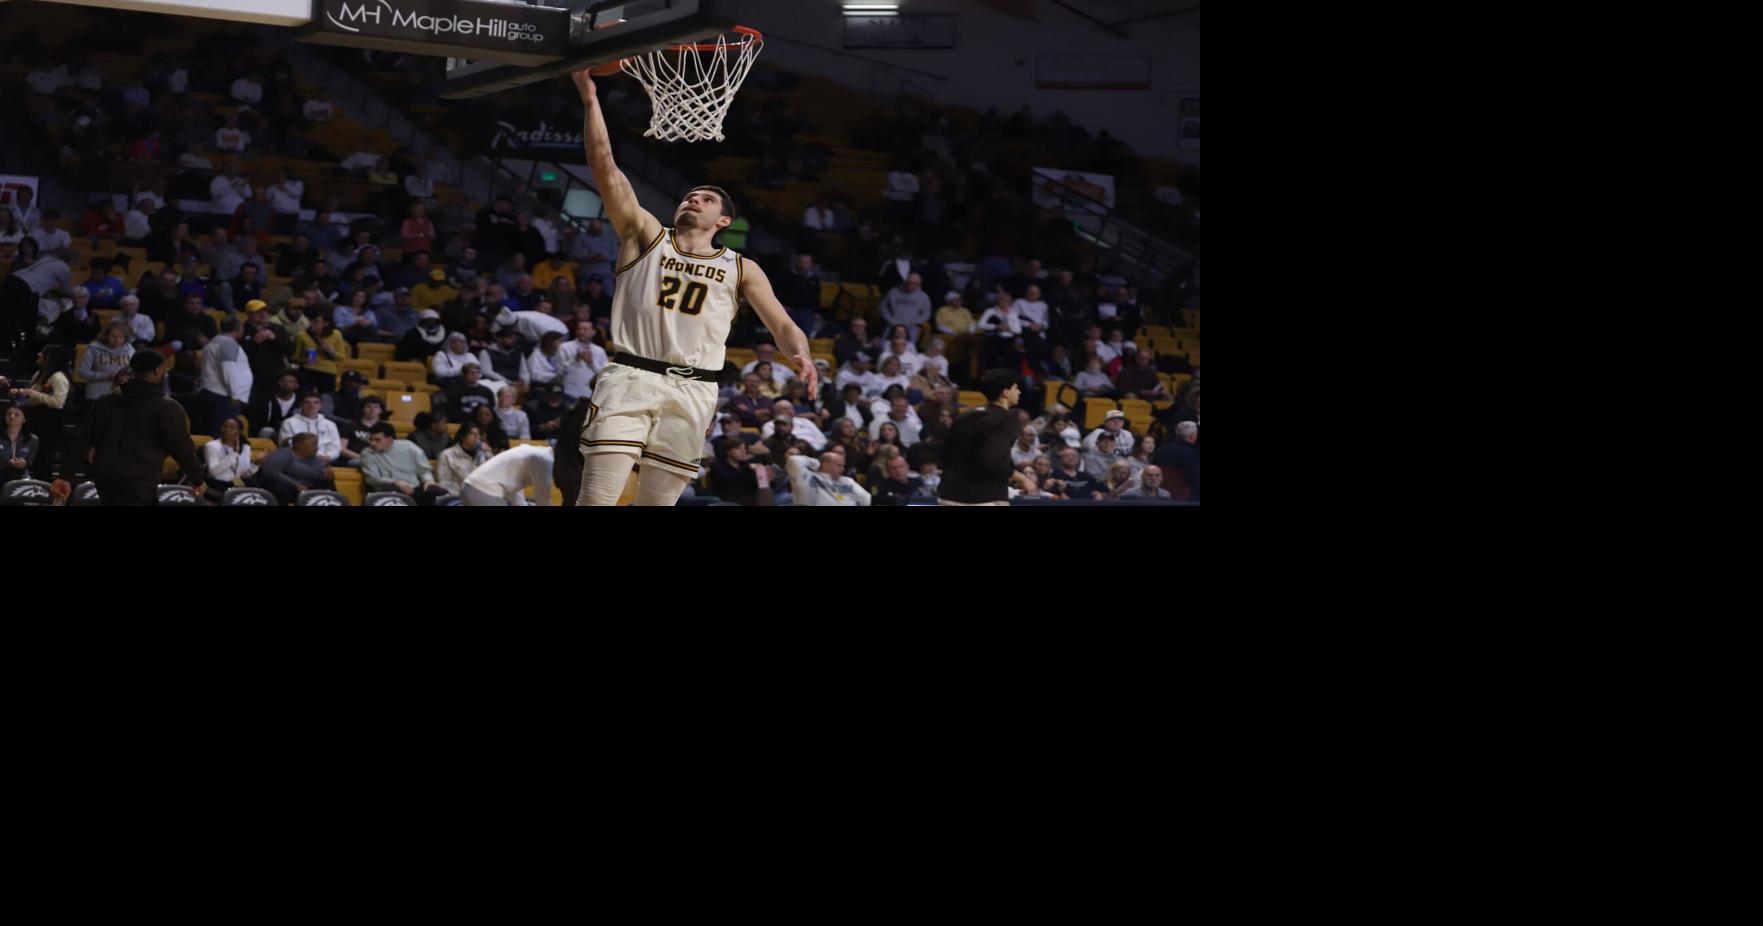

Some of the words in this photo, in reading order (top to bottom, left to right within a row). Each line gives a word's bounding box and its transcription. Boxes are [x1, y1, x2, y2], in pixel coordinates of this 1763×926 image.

[508, 21, 537, 33] auto
[506, 30, 544, 43] group
[657, 276, 708, 315] 20
